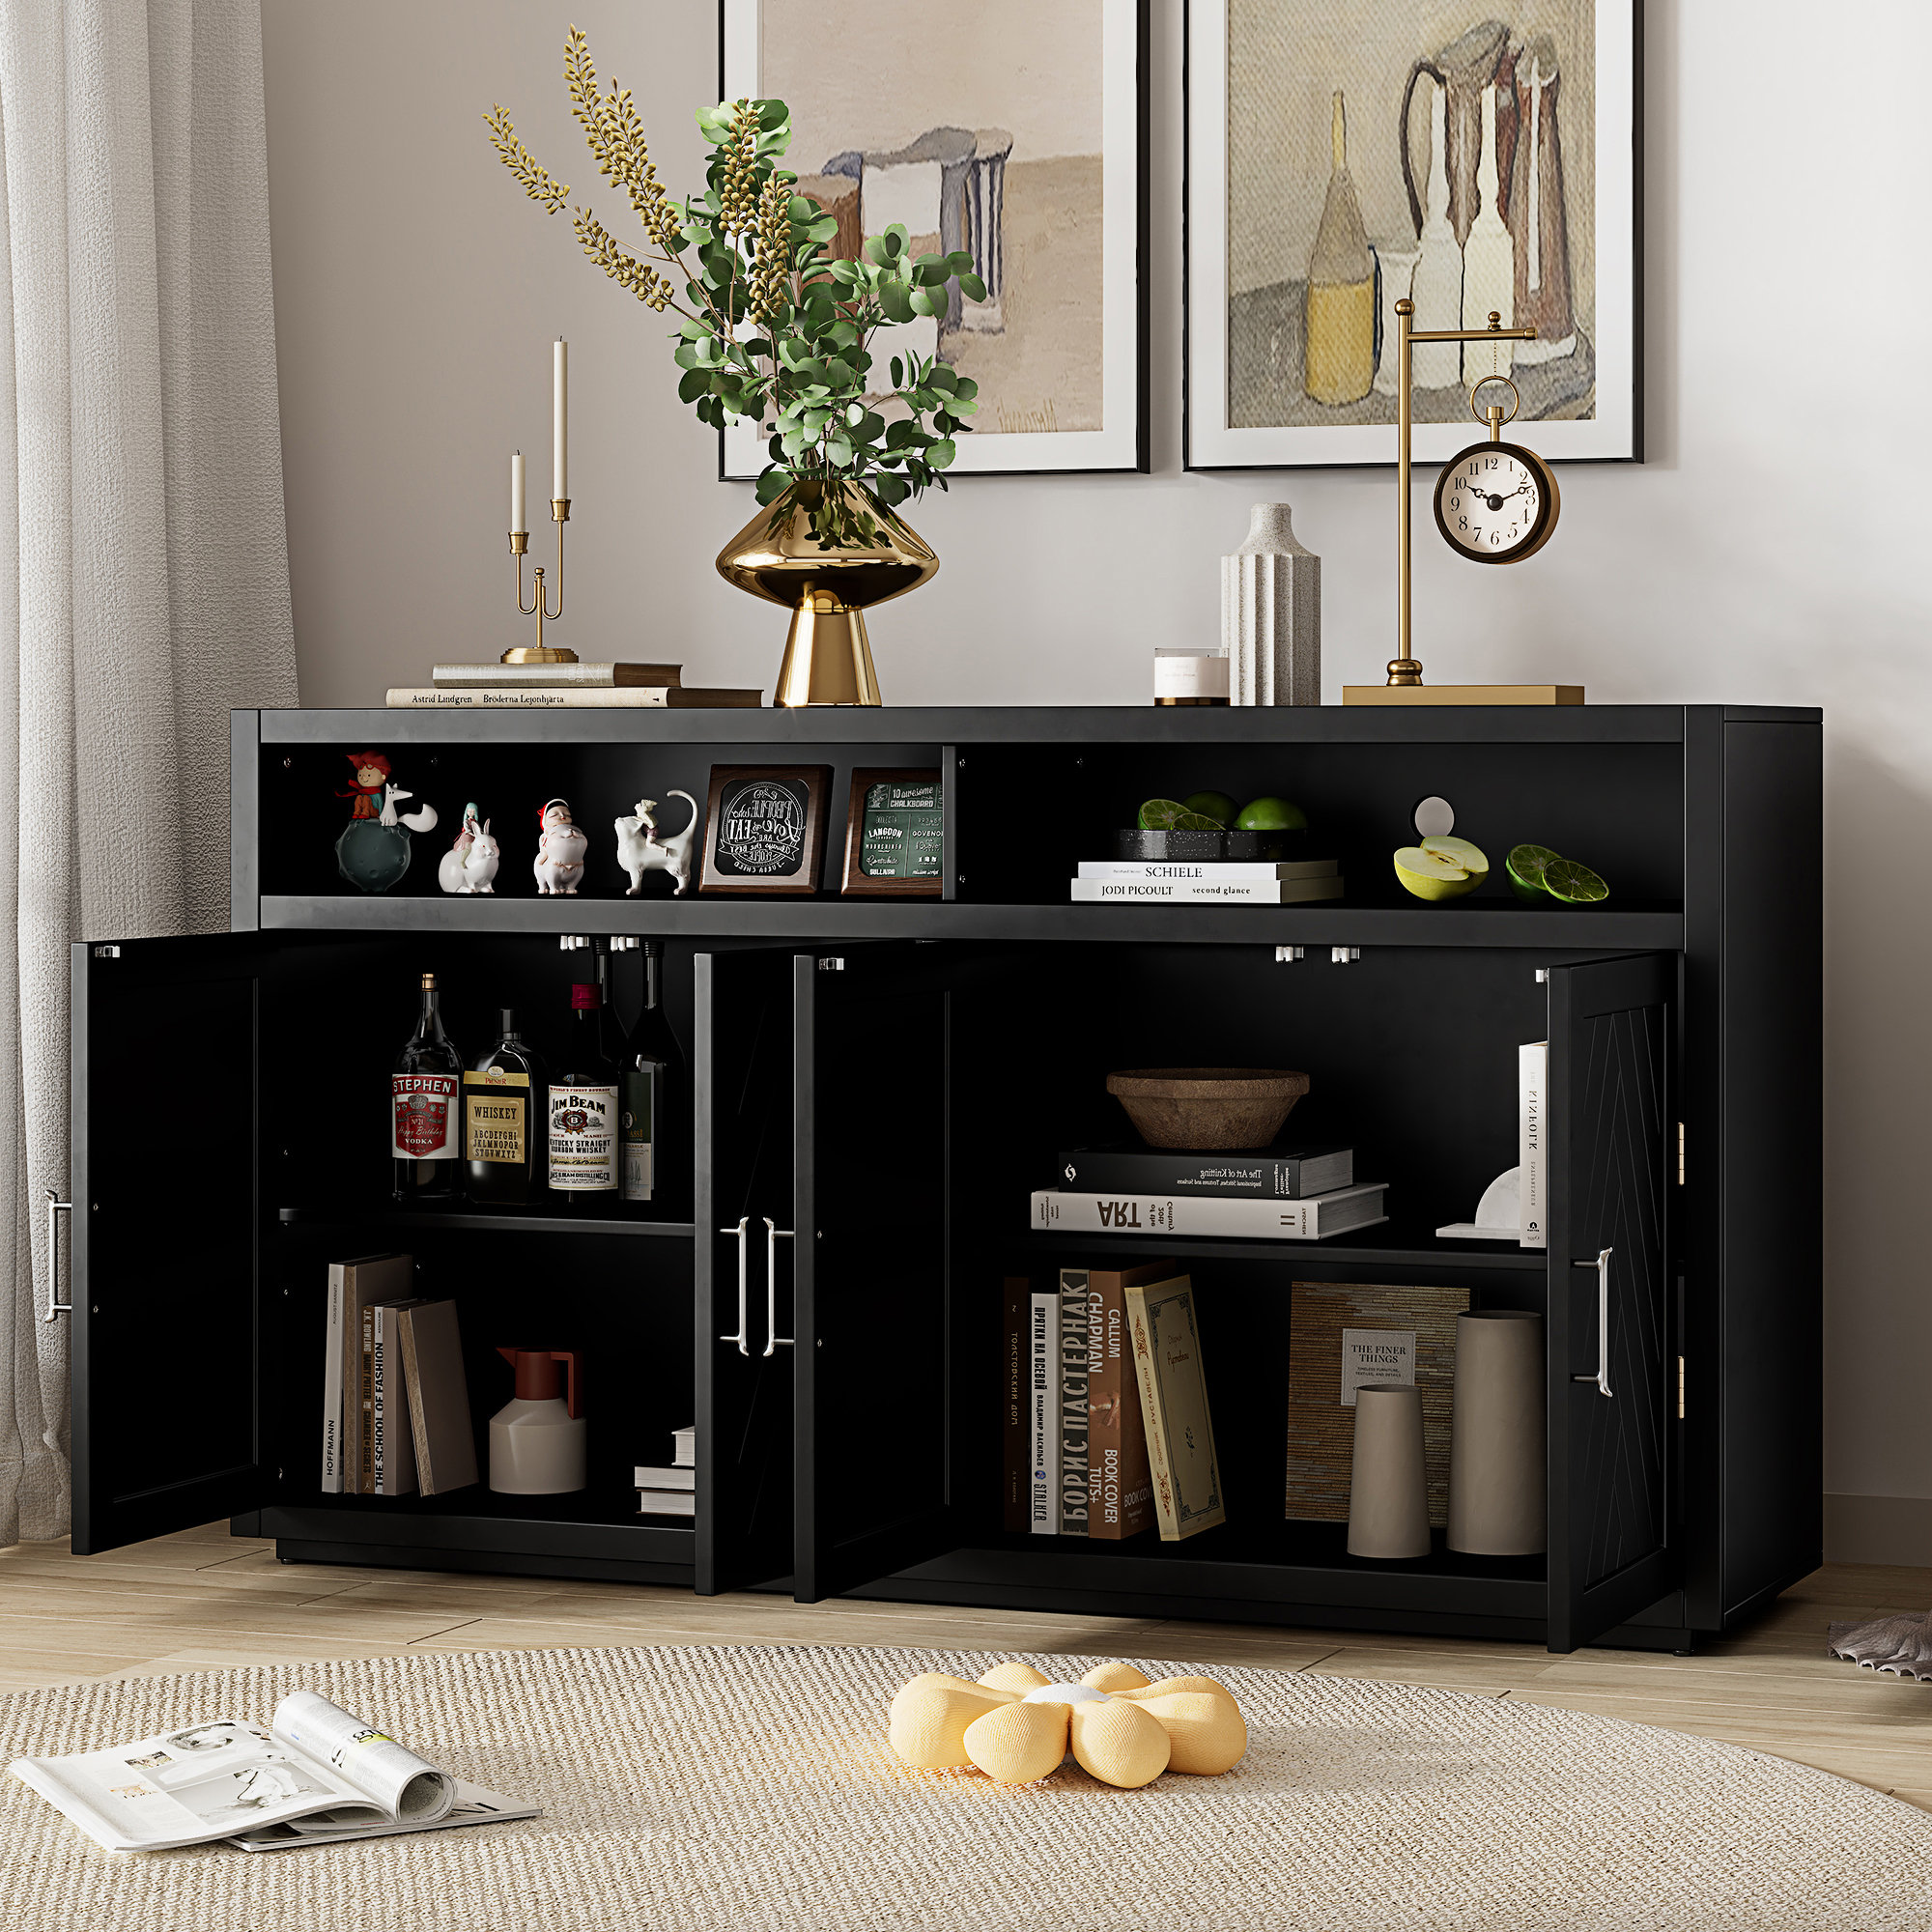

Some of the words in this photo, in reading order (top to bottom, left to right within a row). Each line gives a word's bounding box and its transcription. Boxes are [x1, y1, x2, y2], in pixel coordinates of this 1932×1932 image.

[1469, 462, 1480, 475] 11
[1485, 458, 1498, 469] 12
[1508, 461, 1514, 472] 1
[1455, 477, 1467, 490] 10
[1520, 471, 1528, 485] 2
[1451, 497, 1460, 512] 9
[1525, 489, 1535, 506] 3
[1459, 516, 1468, 530] 8
[1520, 508, 1530, 525] 4
[1473, 527, 1482, 542] 7
[1491, 530, 1499, 546] 6
[1507, 522, 1518, 539] 5
[412, 695, 436, 703] Astrid
[438, 695, 472, 705] Lindgren
[893, 788, 901, 799] 10
[1146, 867, 1203, 878] SCHIELE
[1102, 886, 1125, 896] JODI
[1128, 886, 1174, 895] PICOULT
[1223, 887, 1251, 896] glance
[392, 1078, 451, 1094] STEPHEN
[552, 1098, 567, 1114] JIM
[569, 1095, 606, 1115] BEAM
[474, 1106, 517, 1120] WHISKEY
[474, 1130, 517, 1140] ABCDEFGHI
[473, 1139, 519, 1150] JKLMNOPQR
[475, 1149, 516, 1158] STUVWXYZ
[1035, 1307, 1045, 1340] ПРЯТКИ
[363, 1324, 372, 1352] ROWLING
[1088, 1292, 1103, 1373] CHAPMAN
[1108, 1308, 1121, 1358] CALLUM
[1035, 1343, 1045, 1354] НА
[1063, 1281, 1088, 1430] ПАСТЕРНАК
[1376, 1346, 1406, 1354] FINER
[1359, 1354, 1398, 1363] THINGS
[1035, 1357, 1047, 1390] ОСЕВОЙ
[376, 1396, 384, 1411] OF
[1104, 1449, 1118, 1483] BOOK
[1063, 1439, 1088, 1520] БОРИС
[1089, 1466, 1101, 1504] TUTS+
[1104, 1485, 1118, 1523] COVER
